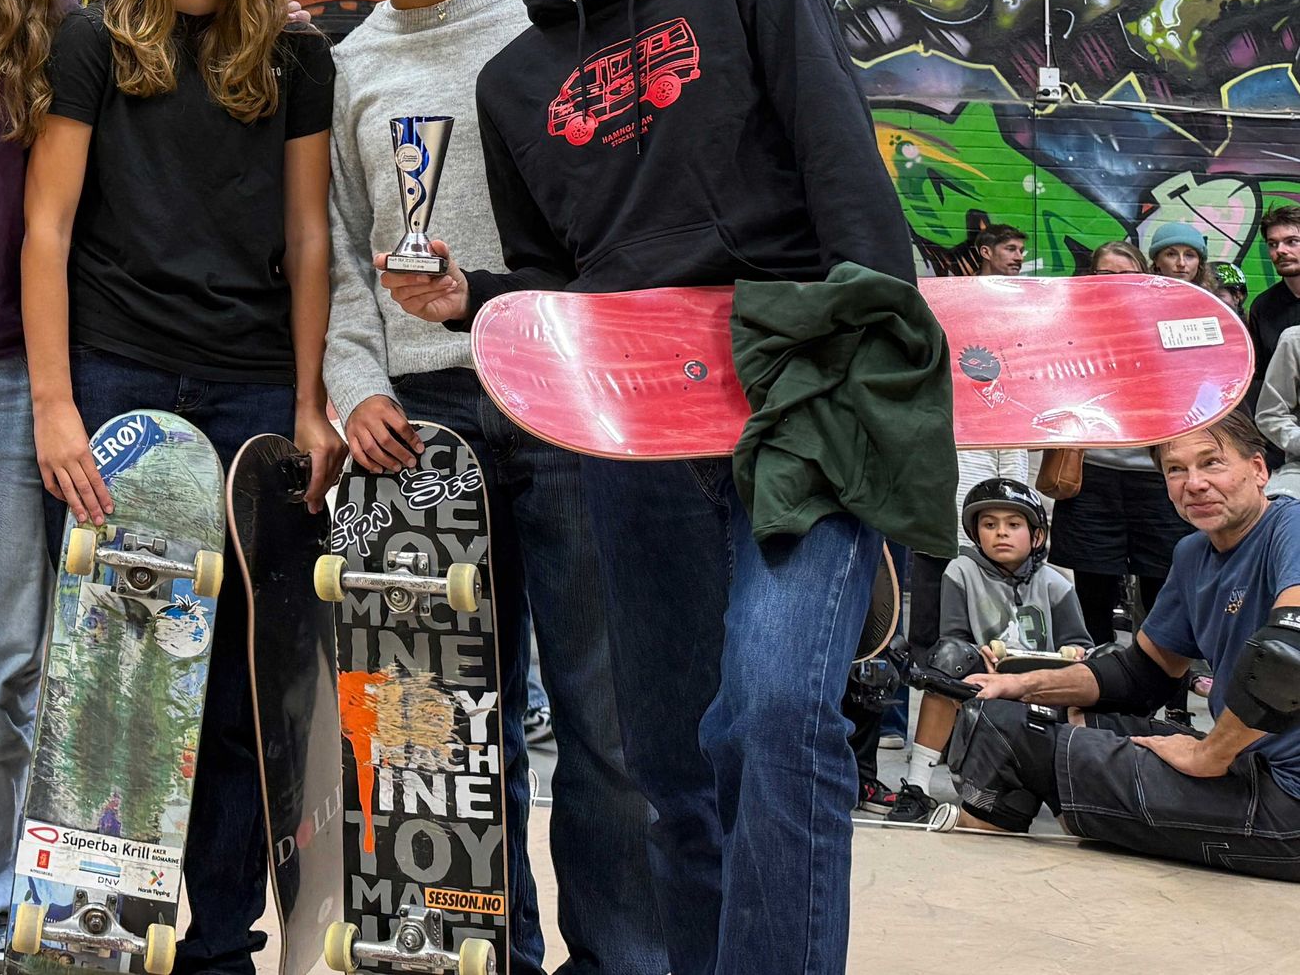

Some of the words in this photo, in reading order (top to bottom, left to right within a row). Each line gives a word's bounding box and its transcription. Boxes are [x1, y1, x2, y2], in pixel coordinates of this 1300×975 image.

[93, 415, 144, 471] ERØY
[379, 768, 494, 820] INE
[62, 832, 117, 854] Superba
[122, 842, 150, 860] Krill
[345, 809, 502, 887] TOY
[98, 877, 120, 886] DNV
[427, 890, 502, 912] SESSION.NO
